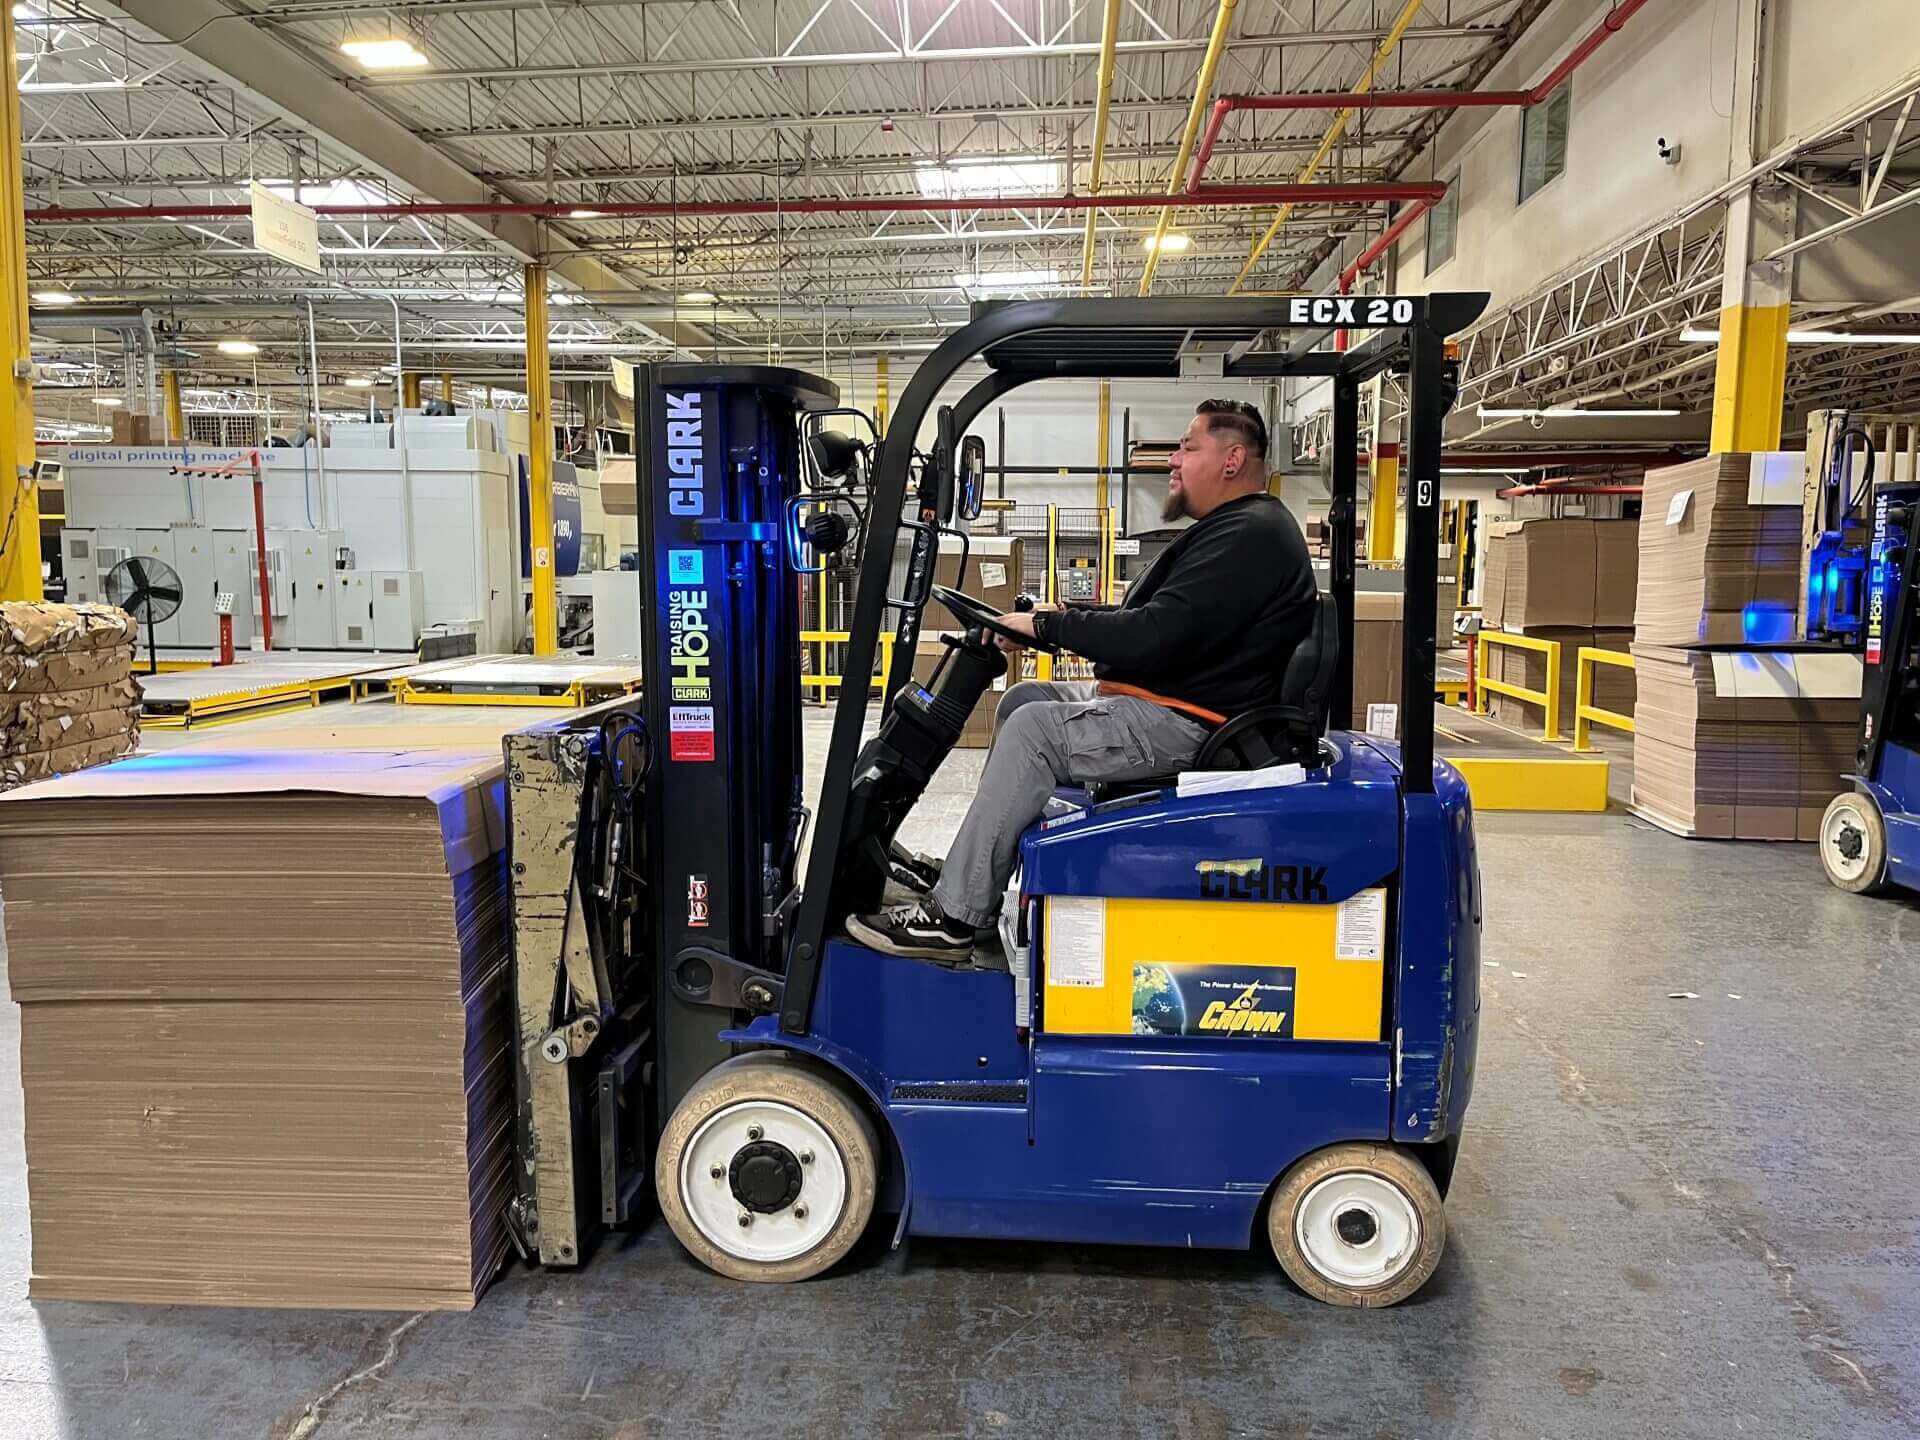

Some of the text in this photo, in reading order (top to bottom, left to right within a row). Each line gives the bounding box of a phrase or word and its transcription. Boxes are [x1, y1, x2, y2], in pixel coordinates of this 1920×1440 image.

[1289, 299, 1413, 323] ECX 20
[68, 449, 122, 462] digital
[127, 449, 196, 462] printing
[666, 392, 705, 516] CLARK
[1420, 482, 1431, 505] 9
[1869, 585, 1884, 636] HOPE
[669, 590, 683, 657] RAISING
[671, 590, 710, 687] HOPE
[675, 688, 708, 699] CLARK
[1200, 980, 1211, 988] The
